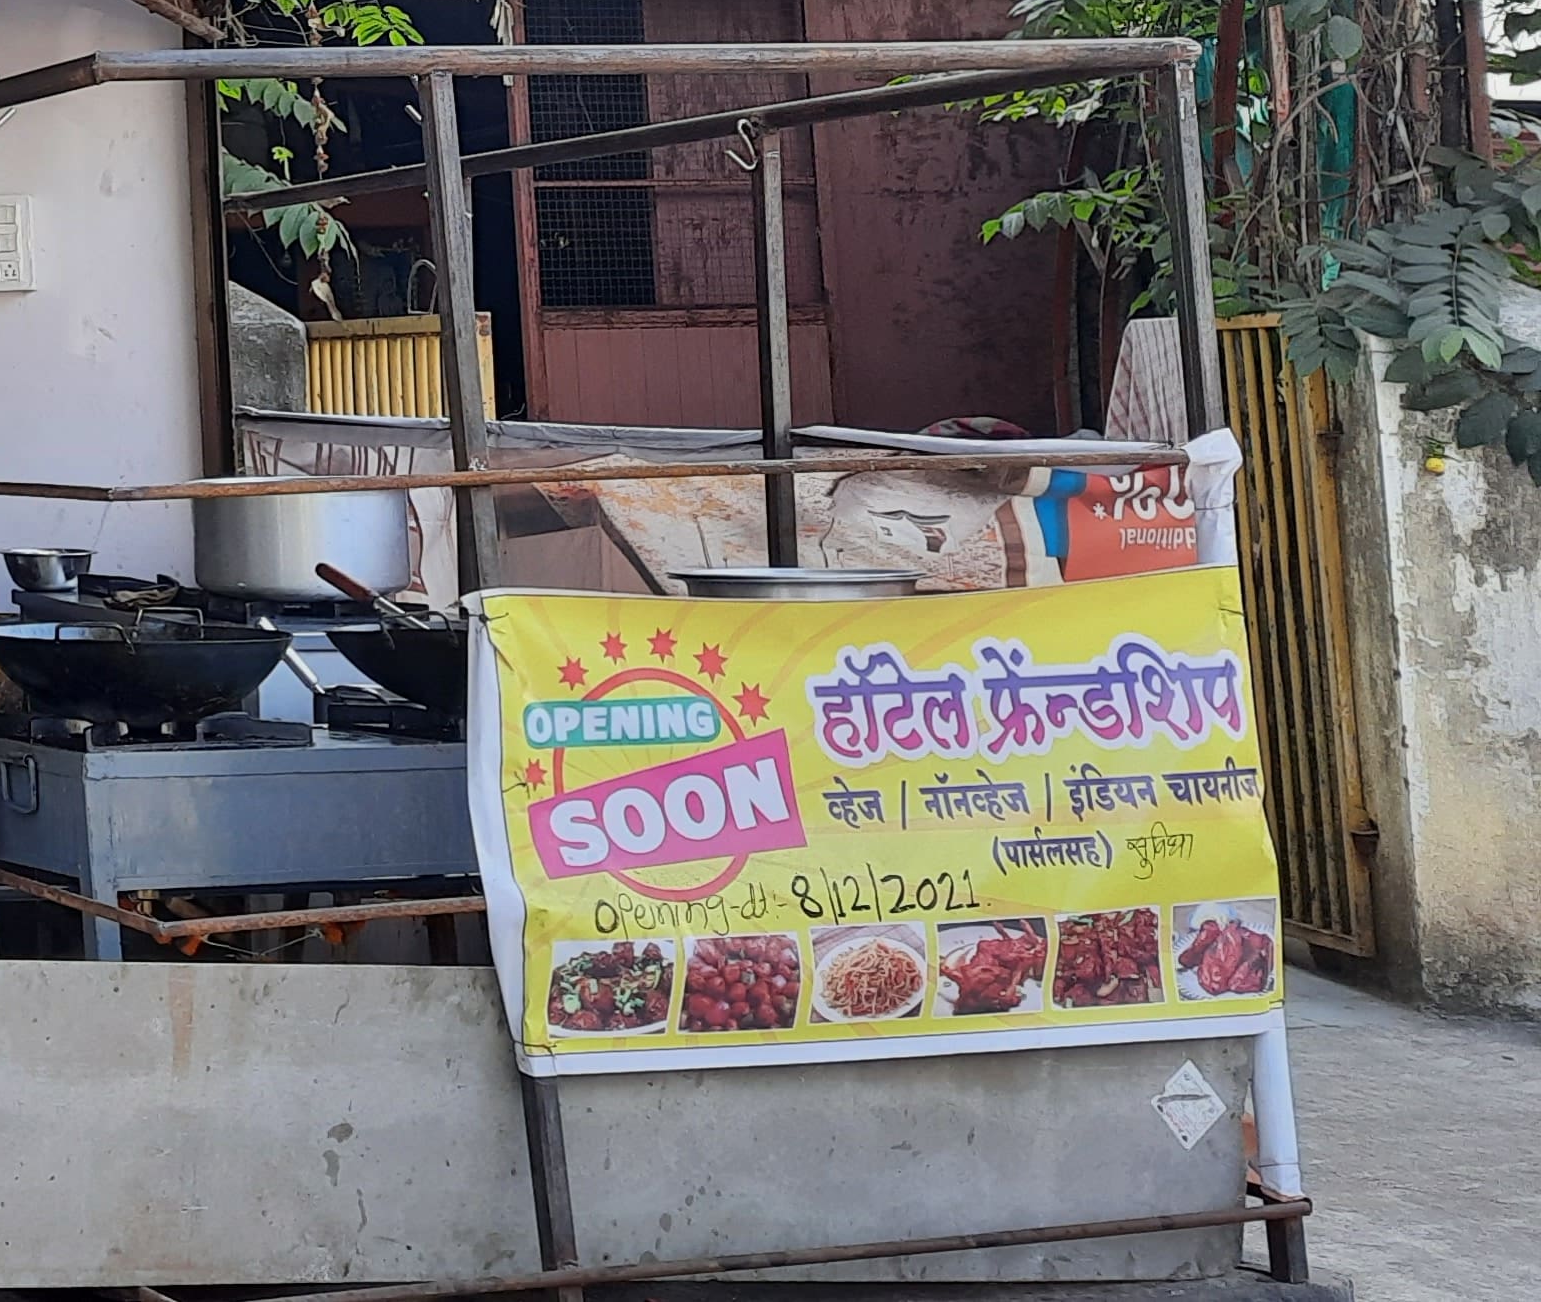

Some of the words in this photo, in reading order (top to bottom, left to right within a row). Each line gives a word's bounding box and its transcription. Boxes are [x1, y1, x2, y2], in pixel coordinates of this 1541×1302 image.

[527, 702, 713, 744] OPENING
[815, 652, 967, 758] हॉटेल
[549, 756, 788, 870] SOON
[823, 779, 885, 828] व्हेज
[919, 771, 1030, 822] नॉनव्हेज
[1065, 763, 1156, 822] इंडियन
[1166, 766, 1262, 805] चायनीज
